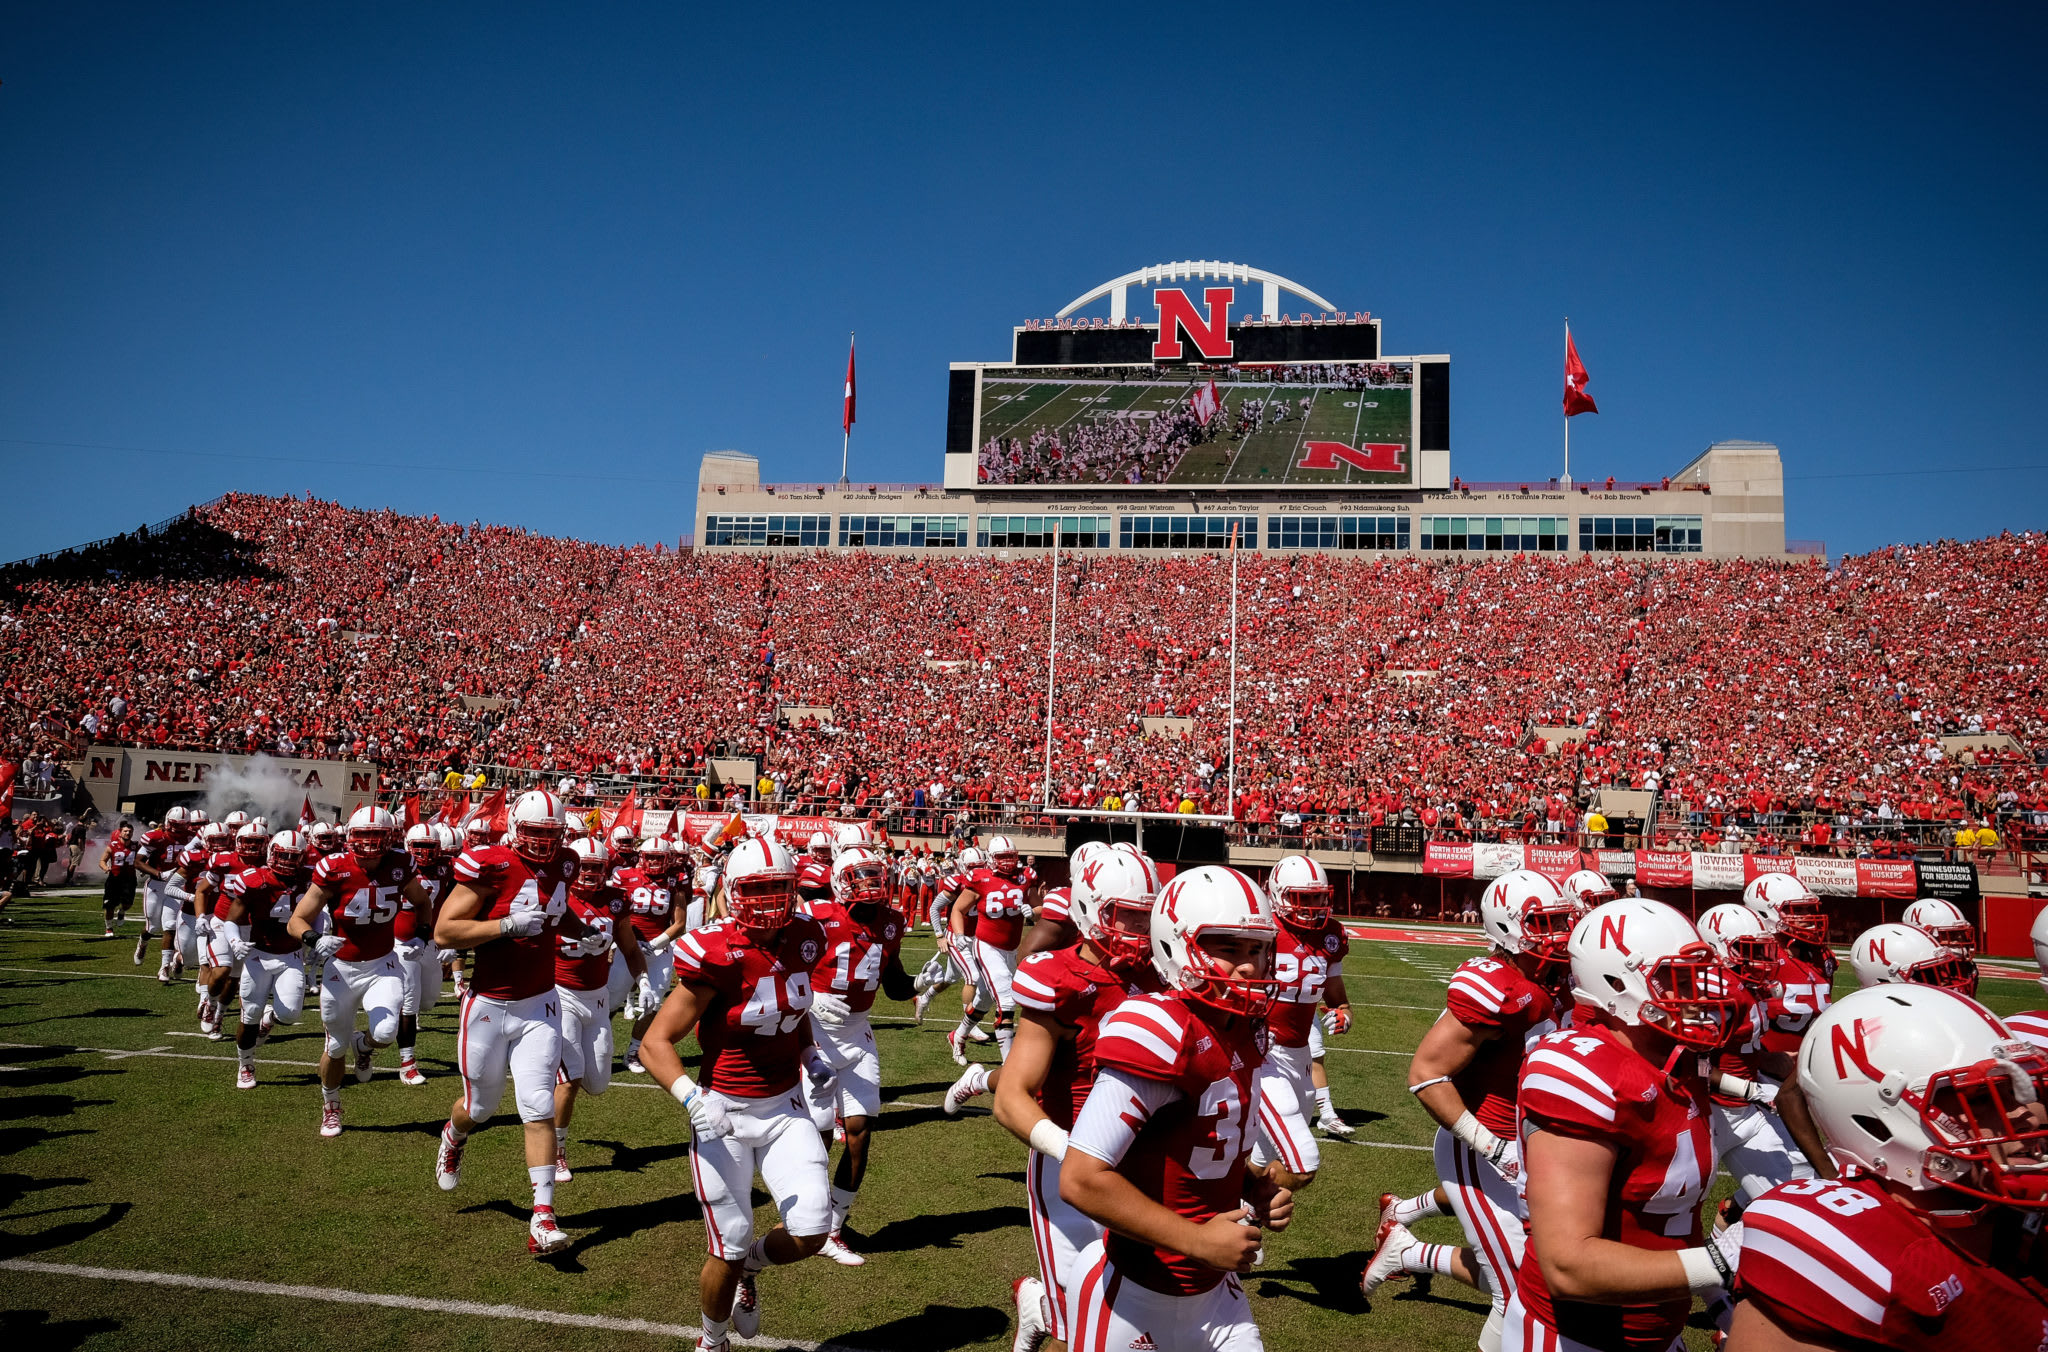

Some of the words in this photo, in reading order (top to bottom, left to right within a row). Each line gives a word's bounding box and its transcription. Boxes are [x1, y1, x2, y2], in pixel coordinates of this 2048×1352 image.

[1024, 316, 1143, 331] MEMORIAL
[1244, 311, 1371, 327] STADIUM
[1152, 287, 1234, 359] N
[1296, 440, 1406, 473] N
[89, 757, 115, 779] N
[350, 772, 371, 792] N
[777, 820, 793, 830] LAS
[795, 820, 823, 830] VEGAS
[902, 817, 947, 834] 2:41
[1429, 845, 1450, 853] NORTH
[1452, 846, 1472, 854] TEXAS
[1531, 849, 1573, 859] SIOUXLAND
[113, 851, 136, 867] 24
[1429, 852, 1473, 861] NEBRASKANS
[1531, 857, 1574, 865] HUSKERS
[1598, 851, 1635, 862] WASHINGTON
[1647, 853, 1682, 863] KANSAS
[1700, 855, 1744, 867] IOWANS
[1752, 857, 1776, 865] TAMPA
[1778, 858, 1793, 866] BAY
[1599, 862, 1636, 874] CORNHUSKERS
[1638, 861, 1676, 870] Cornhusker
[1677, 862, 1692, 871] Club
[1756, 864, 1791, 873] HUSKERS
[1796, 859, 1855, 869] OREGONIANS
[1860, 863, 1882, 871] SOUTH
[1884, 864, 1912, 872] FLORIDA
[1920, 865, 1970, 874] MINNESOTANS
[1800, 876, 1855, 886] NEBRASKA
[1871, 871, 1903, 879] HUSKERS
[1921, 872, 1935, 880] FOR
[1936, 873, 1972, 881] NEBRASKA
[344, 886, 399, 925] 45
[509, 878, 567, 926] 44
[632, 886, 671, 916] 99
[985, 888, 1024, 919] 63
[386, 960, 395, 970] N
[830, 941, 883, 992] 14
[1275, 952, 1328, 1004] 22
[545, 1001, 556, 1018] N
[741, 971, 814, 1036] 49
[1543, 1029, 1606, 1057] 44
[790, 1094, 803, 1111] N
[1780, 1177, 1882, 1217] 38
[1128, 1342, 1159, 1351] adidas
